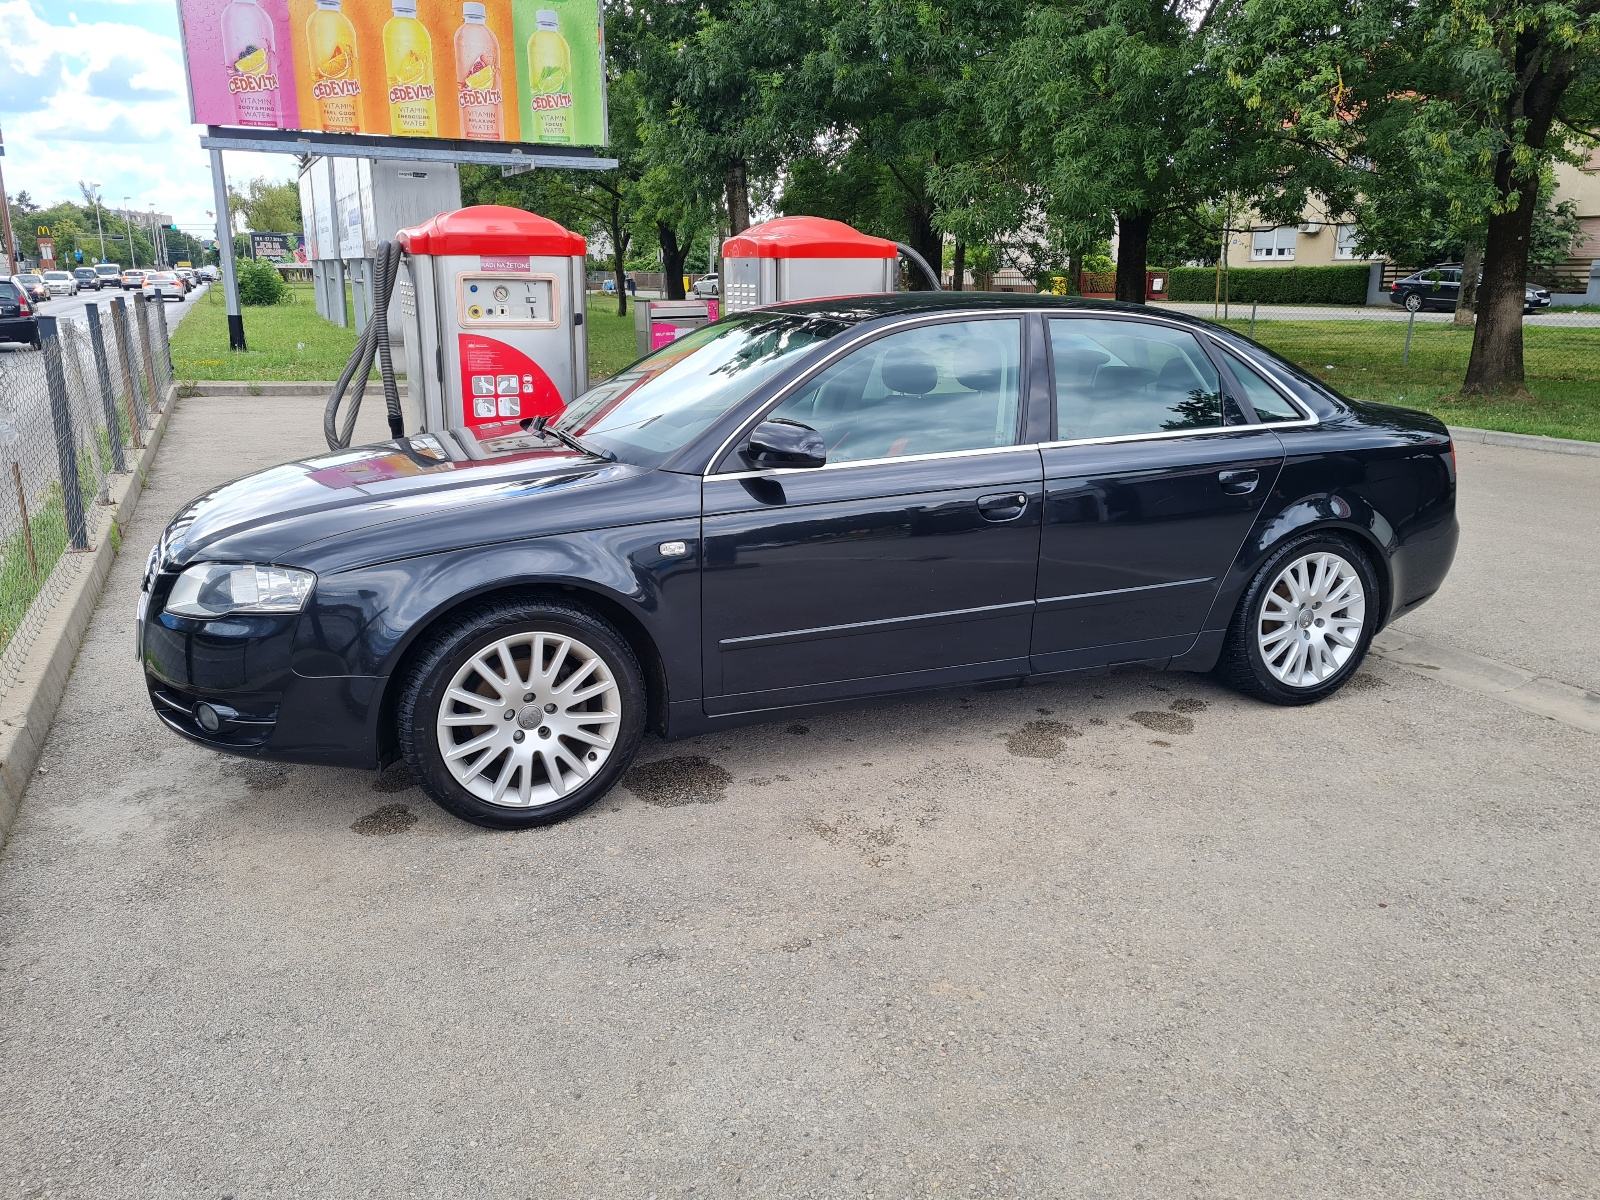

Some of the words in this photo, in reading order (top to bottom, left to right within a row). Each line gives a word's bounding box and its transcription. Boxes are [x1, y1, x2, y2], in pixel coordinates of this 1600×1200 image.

[229, 74, 279, 93] CEDEVITA
[314, 80, 361, 99] CEDEVITA
[239, 97, 272, 105] VITAMIN
[389, 85, 435, 103] CEDEVITA
[459, 90, 503, 107] CEDEVITA
[532, 94, 573, 111] CEDEVITA
[506, 261, 530, 269] ŽETONE
